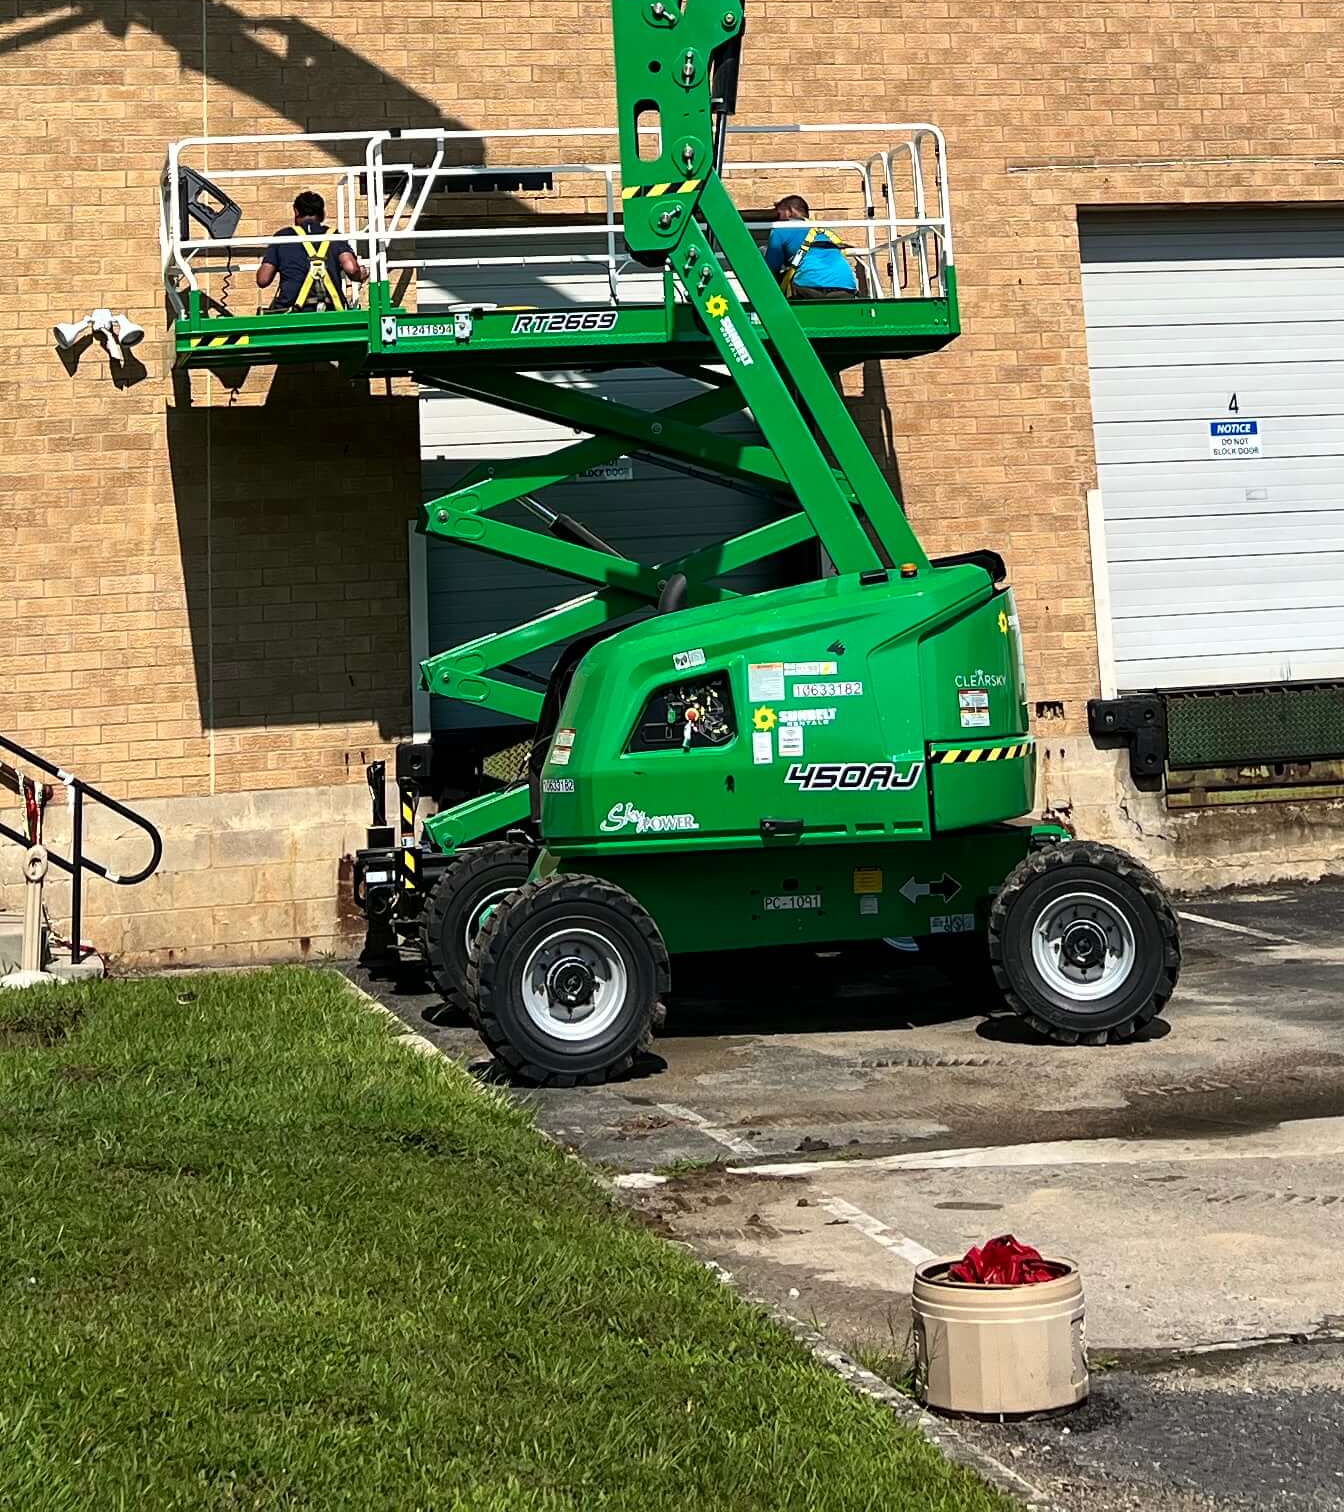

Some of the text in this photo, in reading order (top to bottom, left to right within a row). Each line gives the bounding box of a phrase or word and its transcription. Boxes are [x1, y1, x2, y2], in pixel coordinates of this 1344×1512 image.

[511, 311, 618, 333] RT2669
[720, 316, 754, 366] SUNBELT
[1228, 392, 1239, 414] 4
[1217, 423, 1251, 434] NOTICE
[1221, 437, 1249, 446] DO NOT
[1213, 446, 1260, 456] BLOCK DOOR
[954, 672, 1006, 687] CLEARSKY
[795, 682, 862, 697] 10633182
[778, 708, 837, 722] SUNBELT
[784, 763, 924, 791] 450AJ
[764, 895, 820, 909] PC-1091
